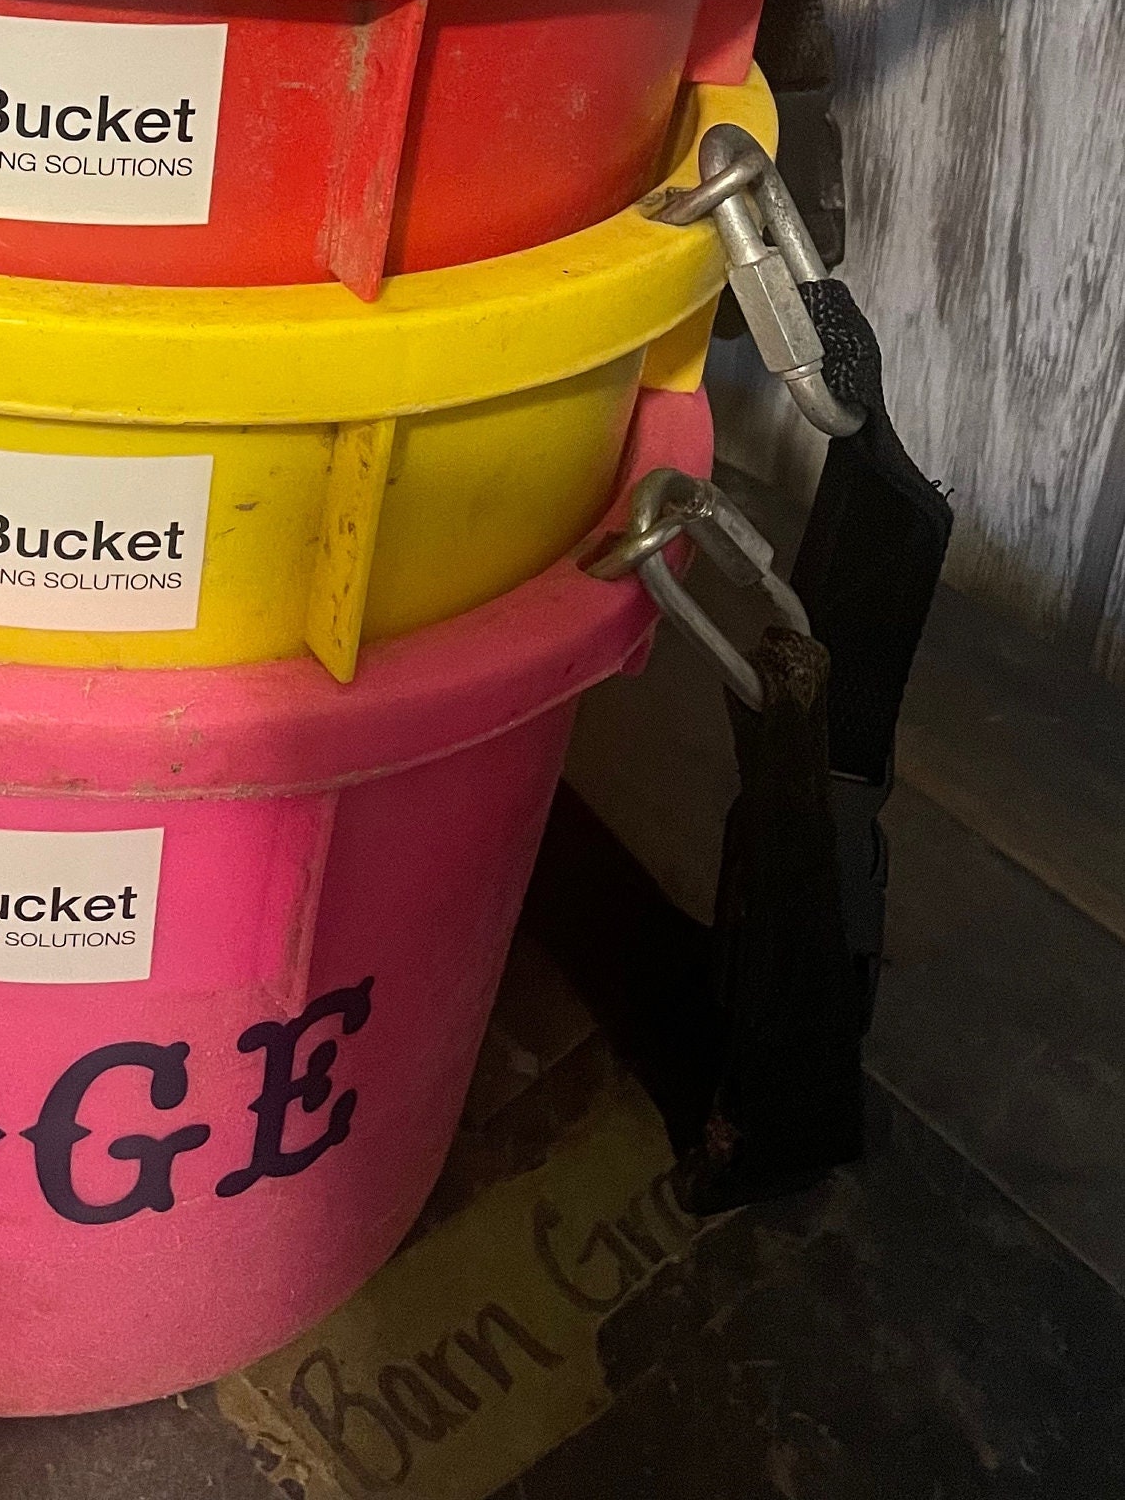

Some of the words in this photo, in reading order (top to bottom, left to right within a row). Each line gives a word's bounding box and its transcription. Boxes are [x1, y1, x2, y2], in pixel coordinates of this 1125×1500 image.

[44, 154, 194, 178] SOLUTIONS
[43, 571, 183, 591] SOLUTIONS
[4, 929, 137, 949] SOLUTIONS
[289, 1302, 565, 1494] Barn
